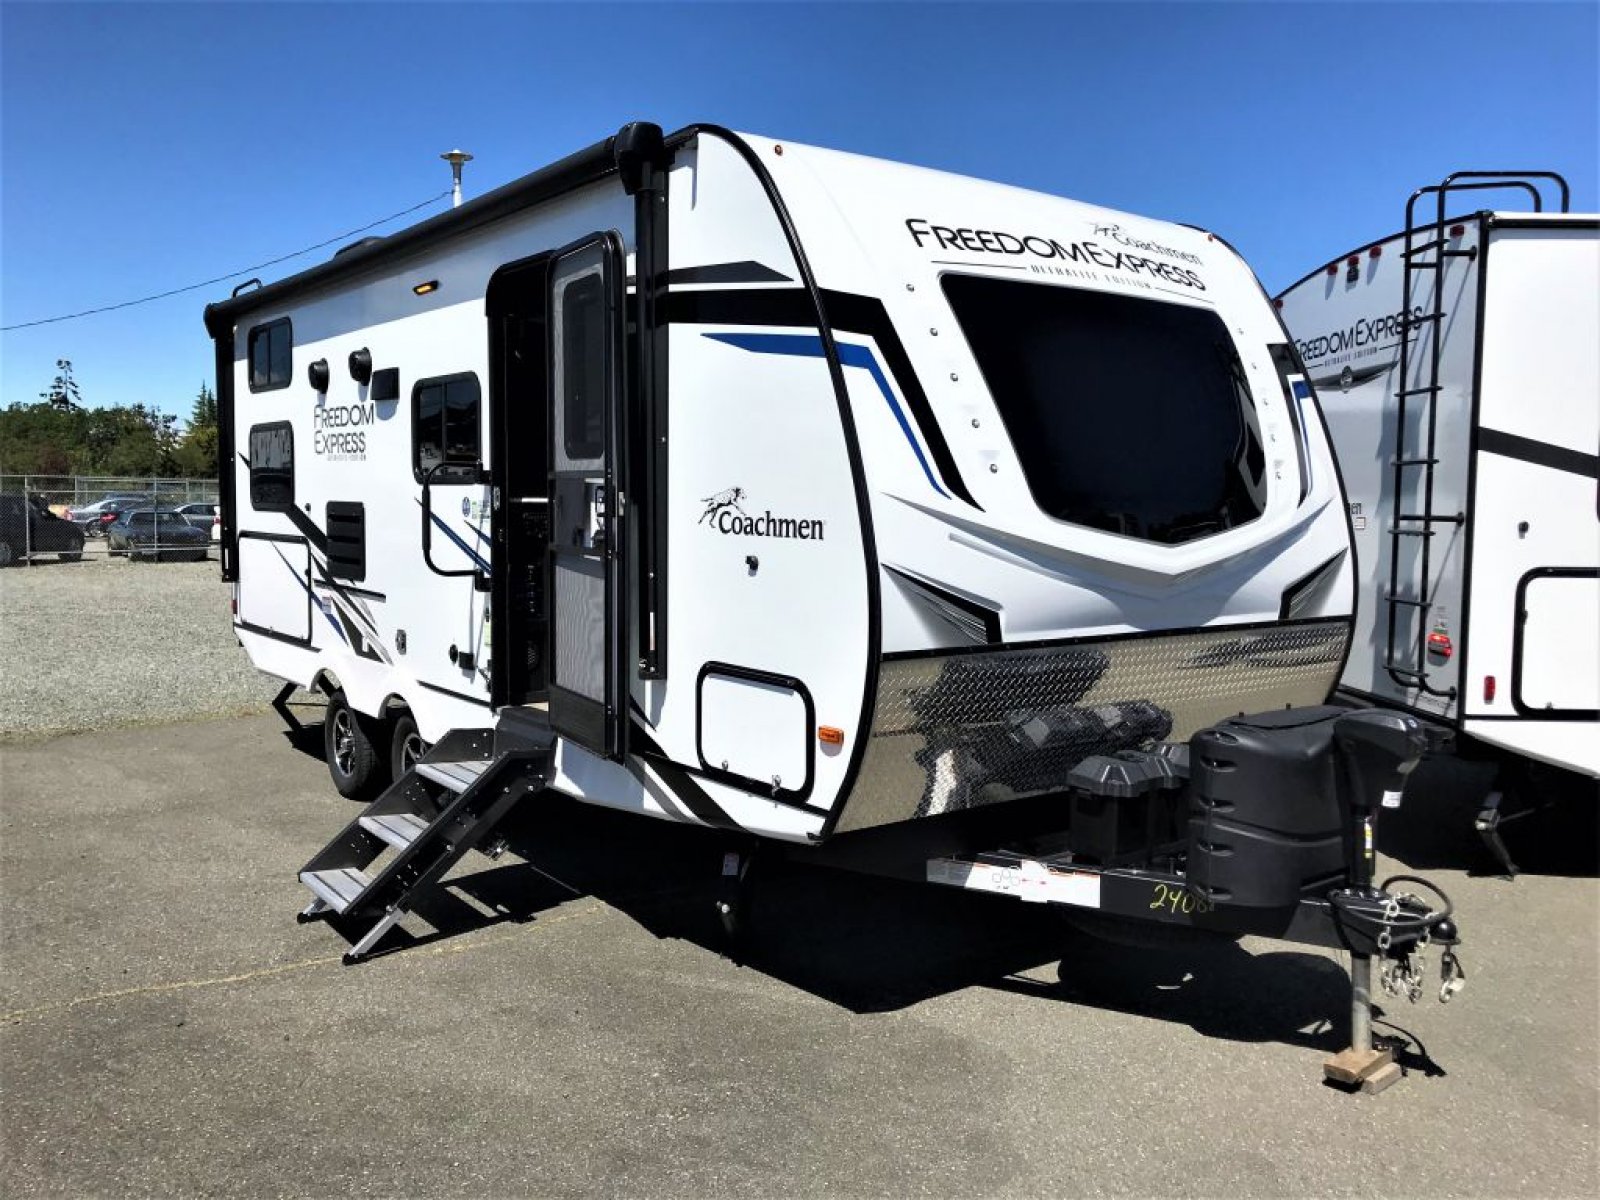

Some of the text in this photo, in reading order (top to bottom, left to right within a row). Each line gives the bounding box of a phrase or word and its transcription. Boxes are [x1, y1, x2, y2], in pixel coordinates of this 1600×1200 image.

[314, 402, 374, 428] FREEDOM
[314, 430, 366, 455] EXPRESS
[718, 510, 824, 541] Coachmen
